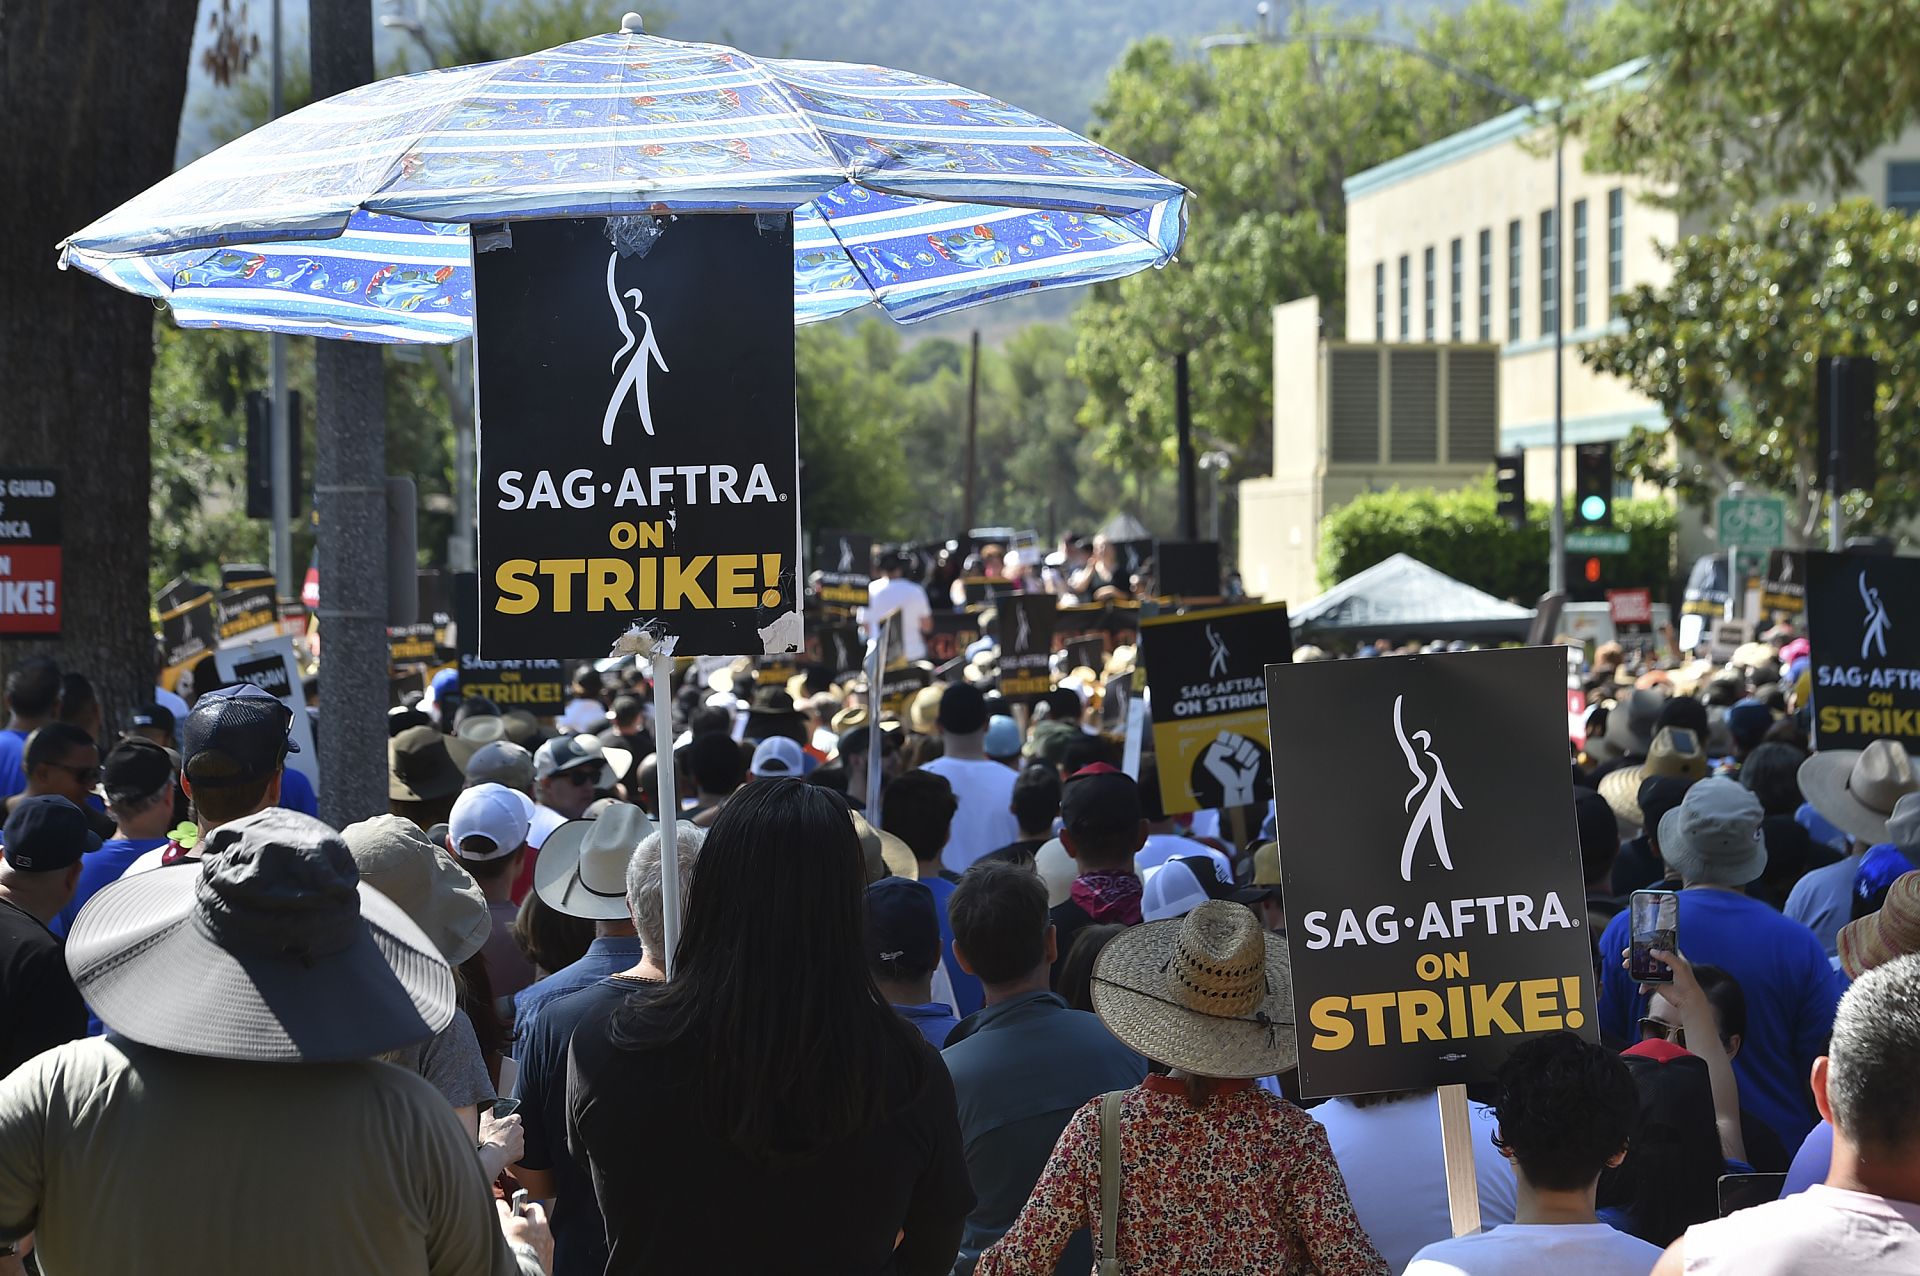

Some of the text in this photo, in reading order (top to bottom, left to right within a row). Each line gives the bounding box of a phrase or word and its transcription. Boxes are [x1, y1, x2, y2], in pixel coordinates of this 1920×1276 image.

[8, 480, 56, 497] GUILD
[609, 521, 664, 550] ON
[495, 554, 782, 614] STRIKE!
[463, 683, 561, 703] STRIKE!
[1868, 691, 1894, 706] ON
[1173, 701, 1202, 716] ON
[1416, 951, 1469, 981] ON
[1309, 976, 1585, 1051] STRIKE!
